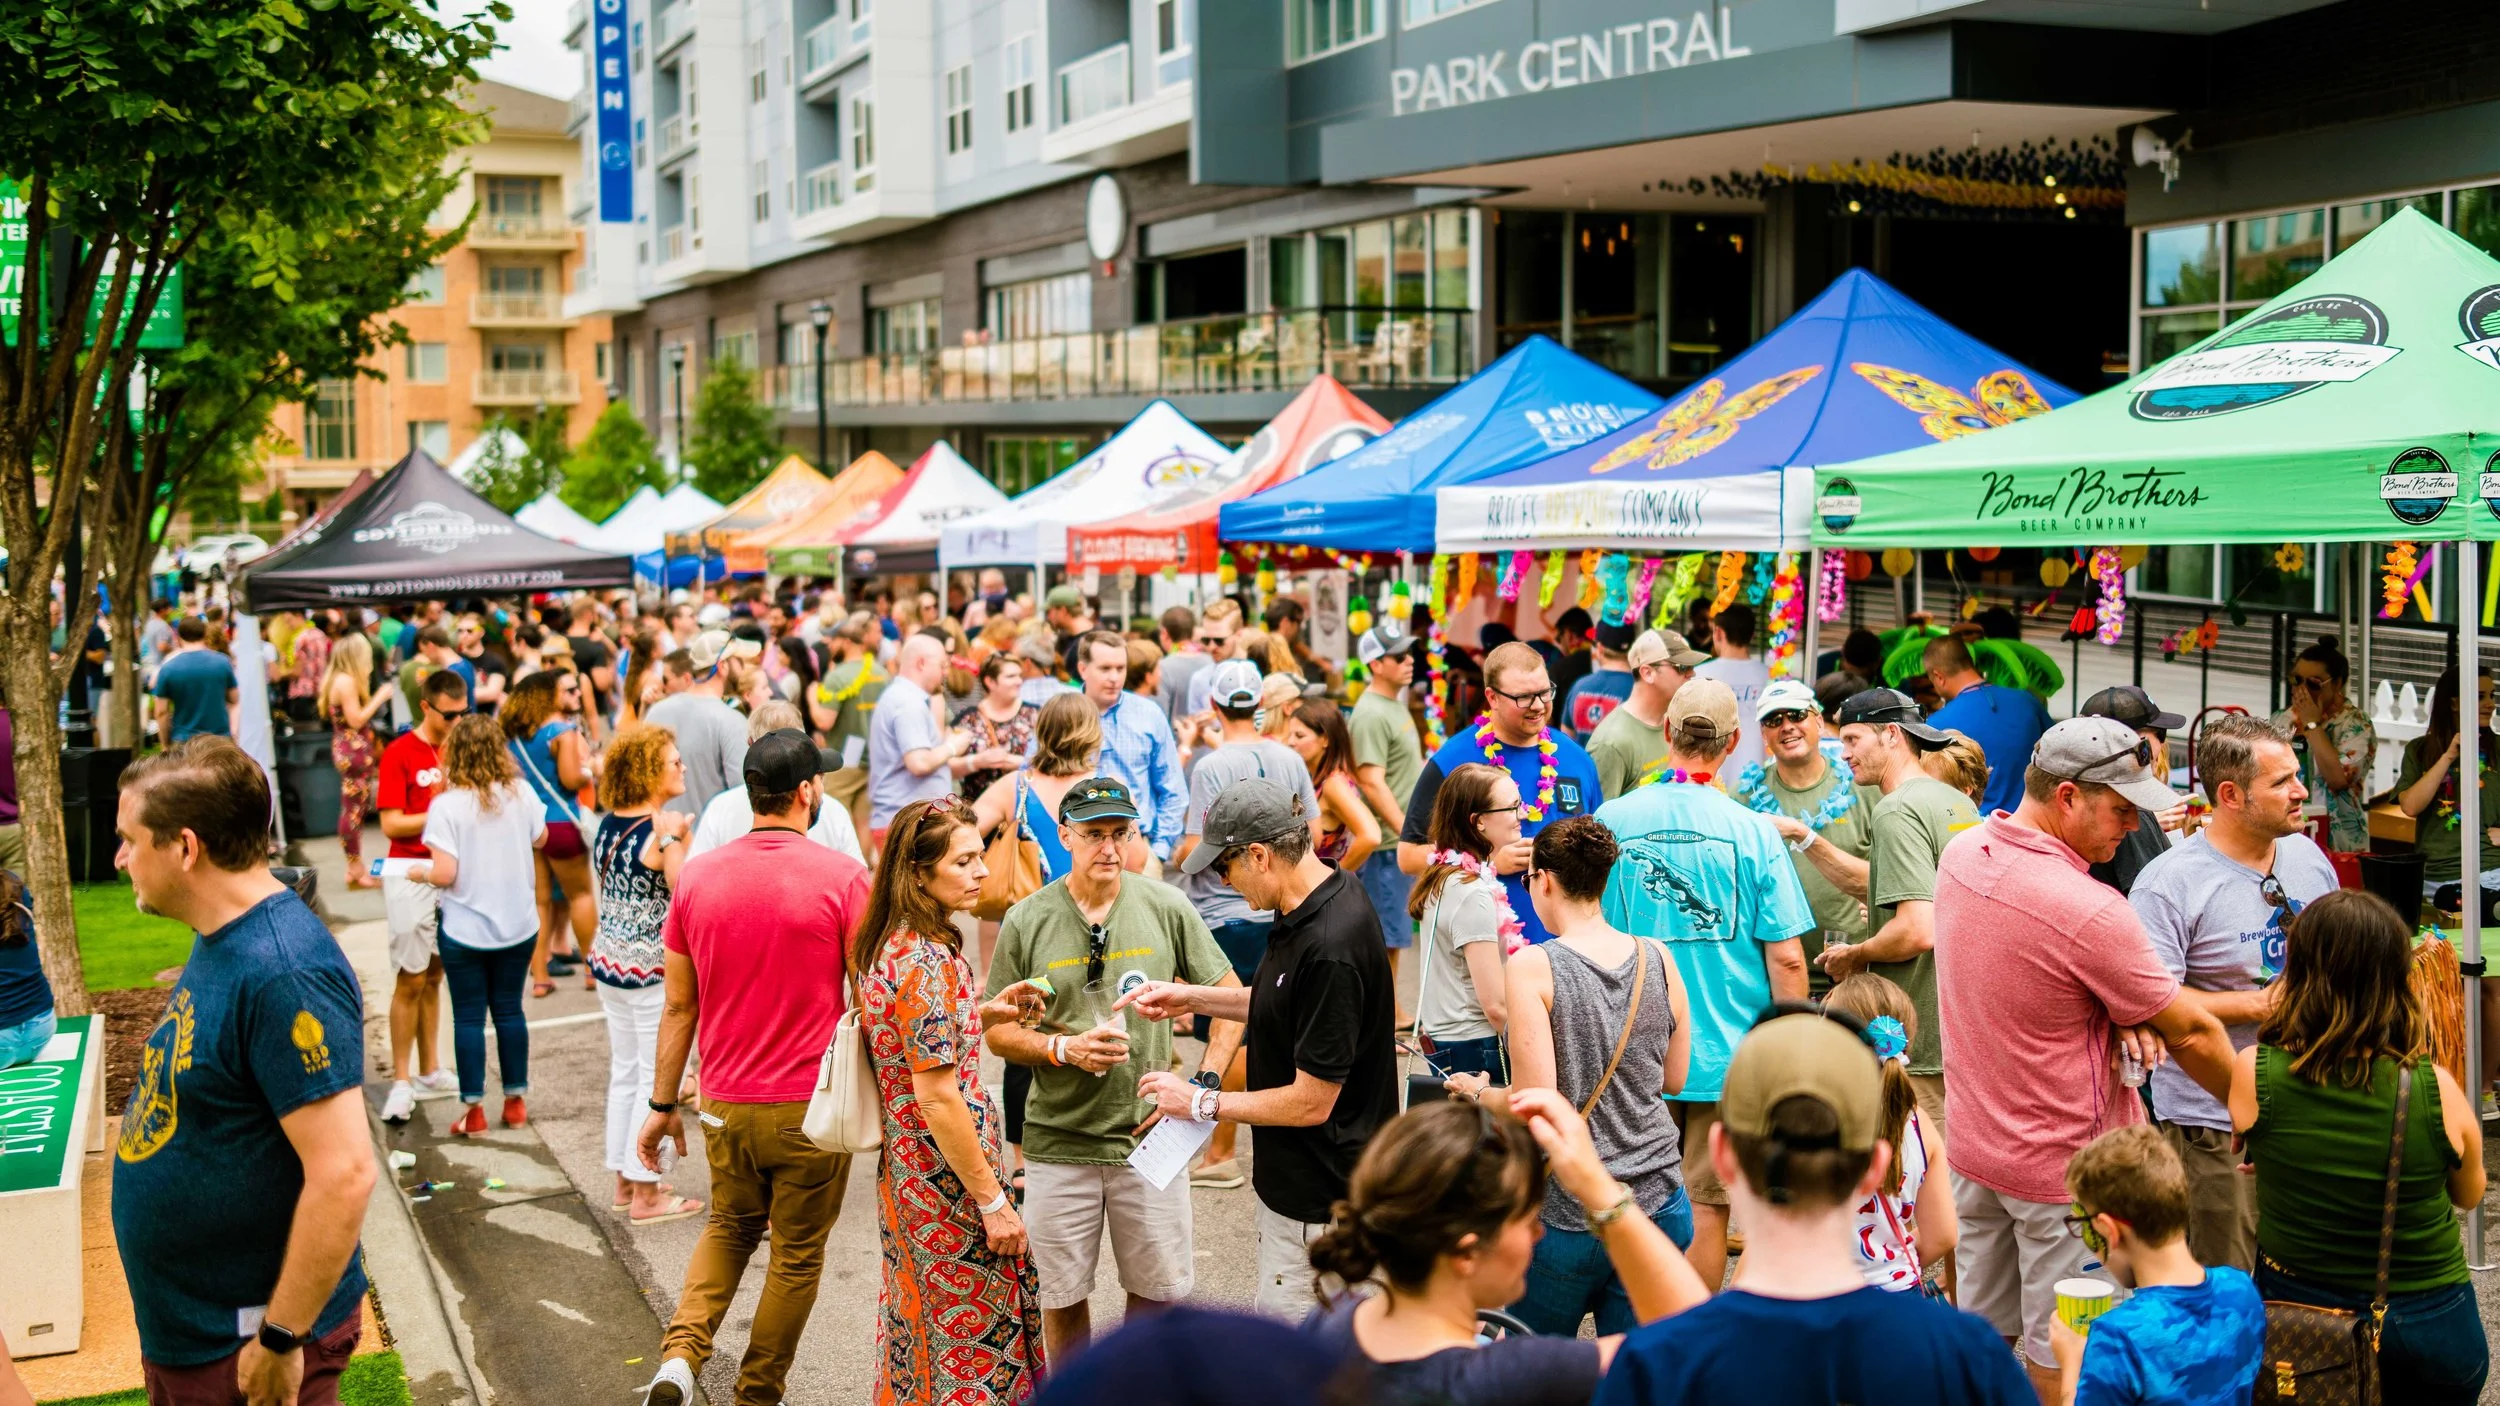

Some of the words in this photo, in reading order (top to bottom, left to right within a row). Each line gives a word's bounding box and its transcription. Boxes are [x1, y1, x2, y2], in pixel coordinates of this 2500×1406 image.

[1391, 50, 1509, 116] PARK
[1518, 7, 1752, 92] CENTRAL
[2230, 347, 2376, 373] Brothers
[1976, 471, 2067, 520] Bond
[2063, 466, 2209, 519] Brothers
[2382, 477, 2414, 491] Bond
[2412, 475, 2456, 491] Brothers
[1617, 487, 1710, 537] COMPANY
[2021, 519, 2058, 532] BEER
[2074, 517, 2147, 530] COMPANY
[1647, 833, 1667, 841] GREEN
[1669, 833, 1690, 841] TURTLE
[1047, 957, 1080, 970] DRINK
[1110, 951, 1123, 960] DO
[1125, 947, 1154, 957] GOOD.
